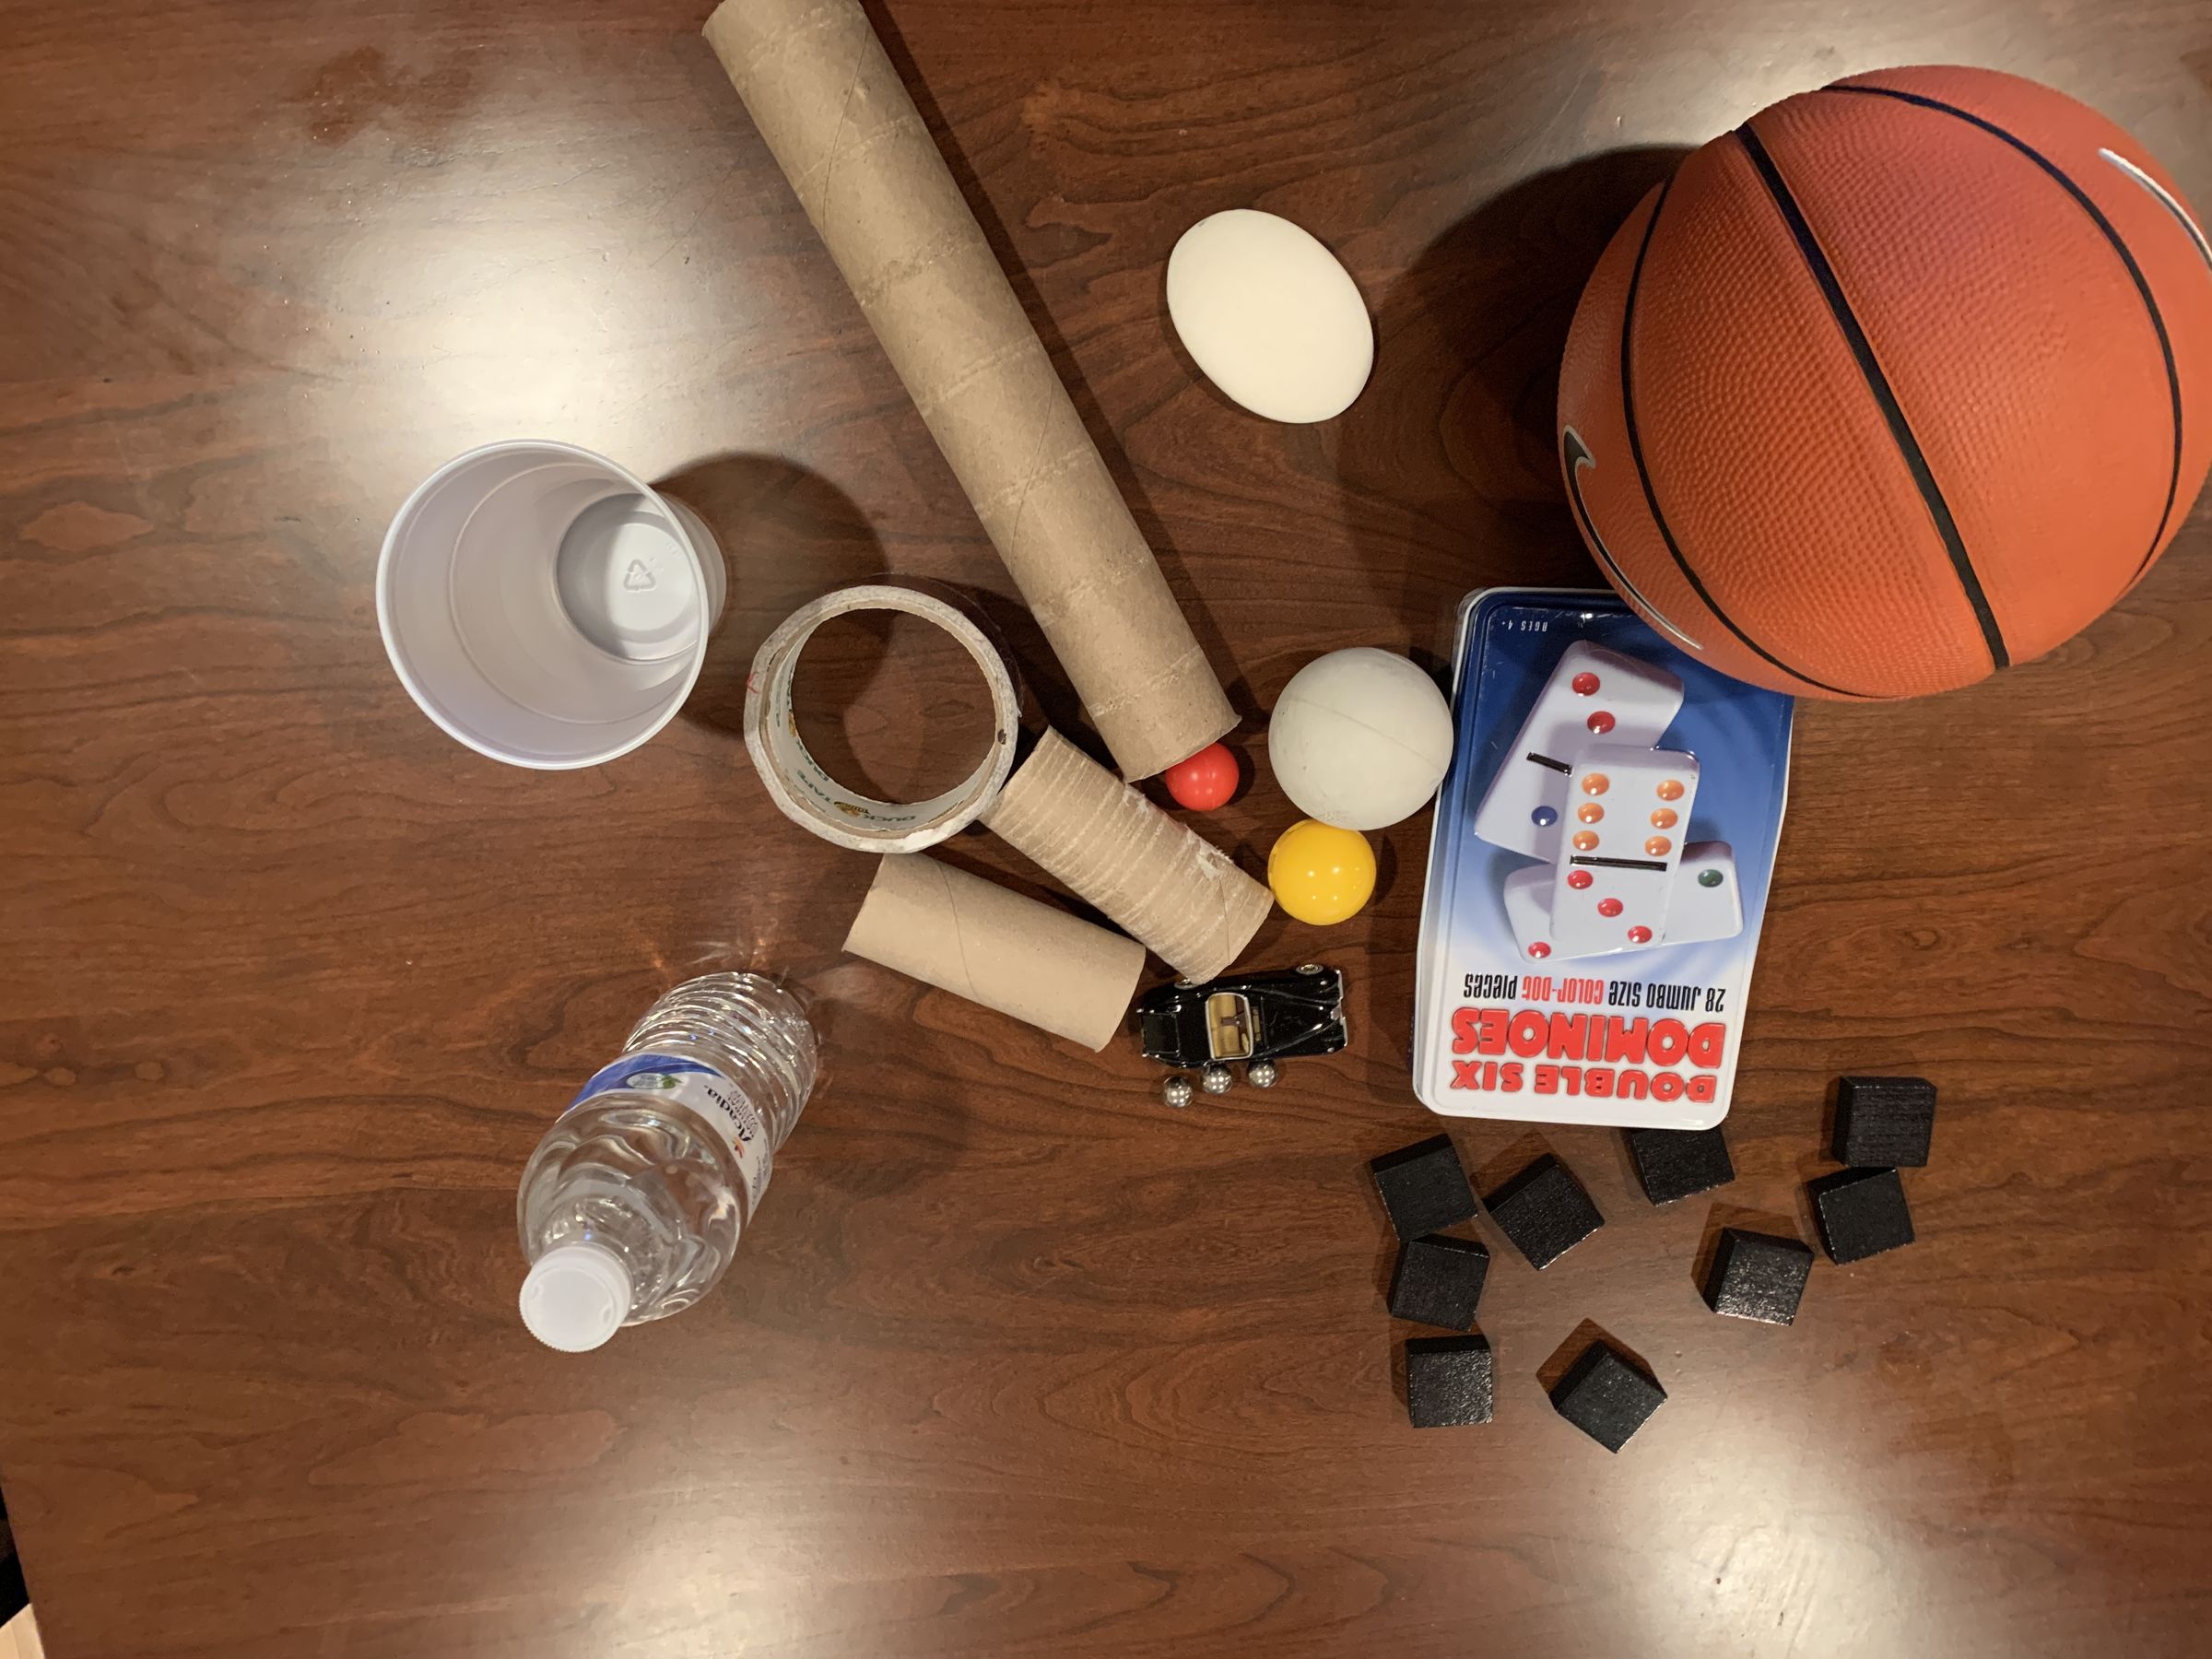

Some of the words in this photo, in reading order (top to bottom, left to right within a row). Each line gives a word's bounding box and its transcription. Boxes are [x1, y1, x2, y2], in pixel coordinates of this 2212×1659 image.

[1520, 619, 1548, 632] AGES
[1705, 986, 1727, 1013] 28
[1450, 1006, 1727, 1070] DOMINOES
[1449, 1059, 1524, 1092] SIX
[1534, 1065, 1718, 1104] DOUBLE
[707, 1088, 751, 1142] Acadia
